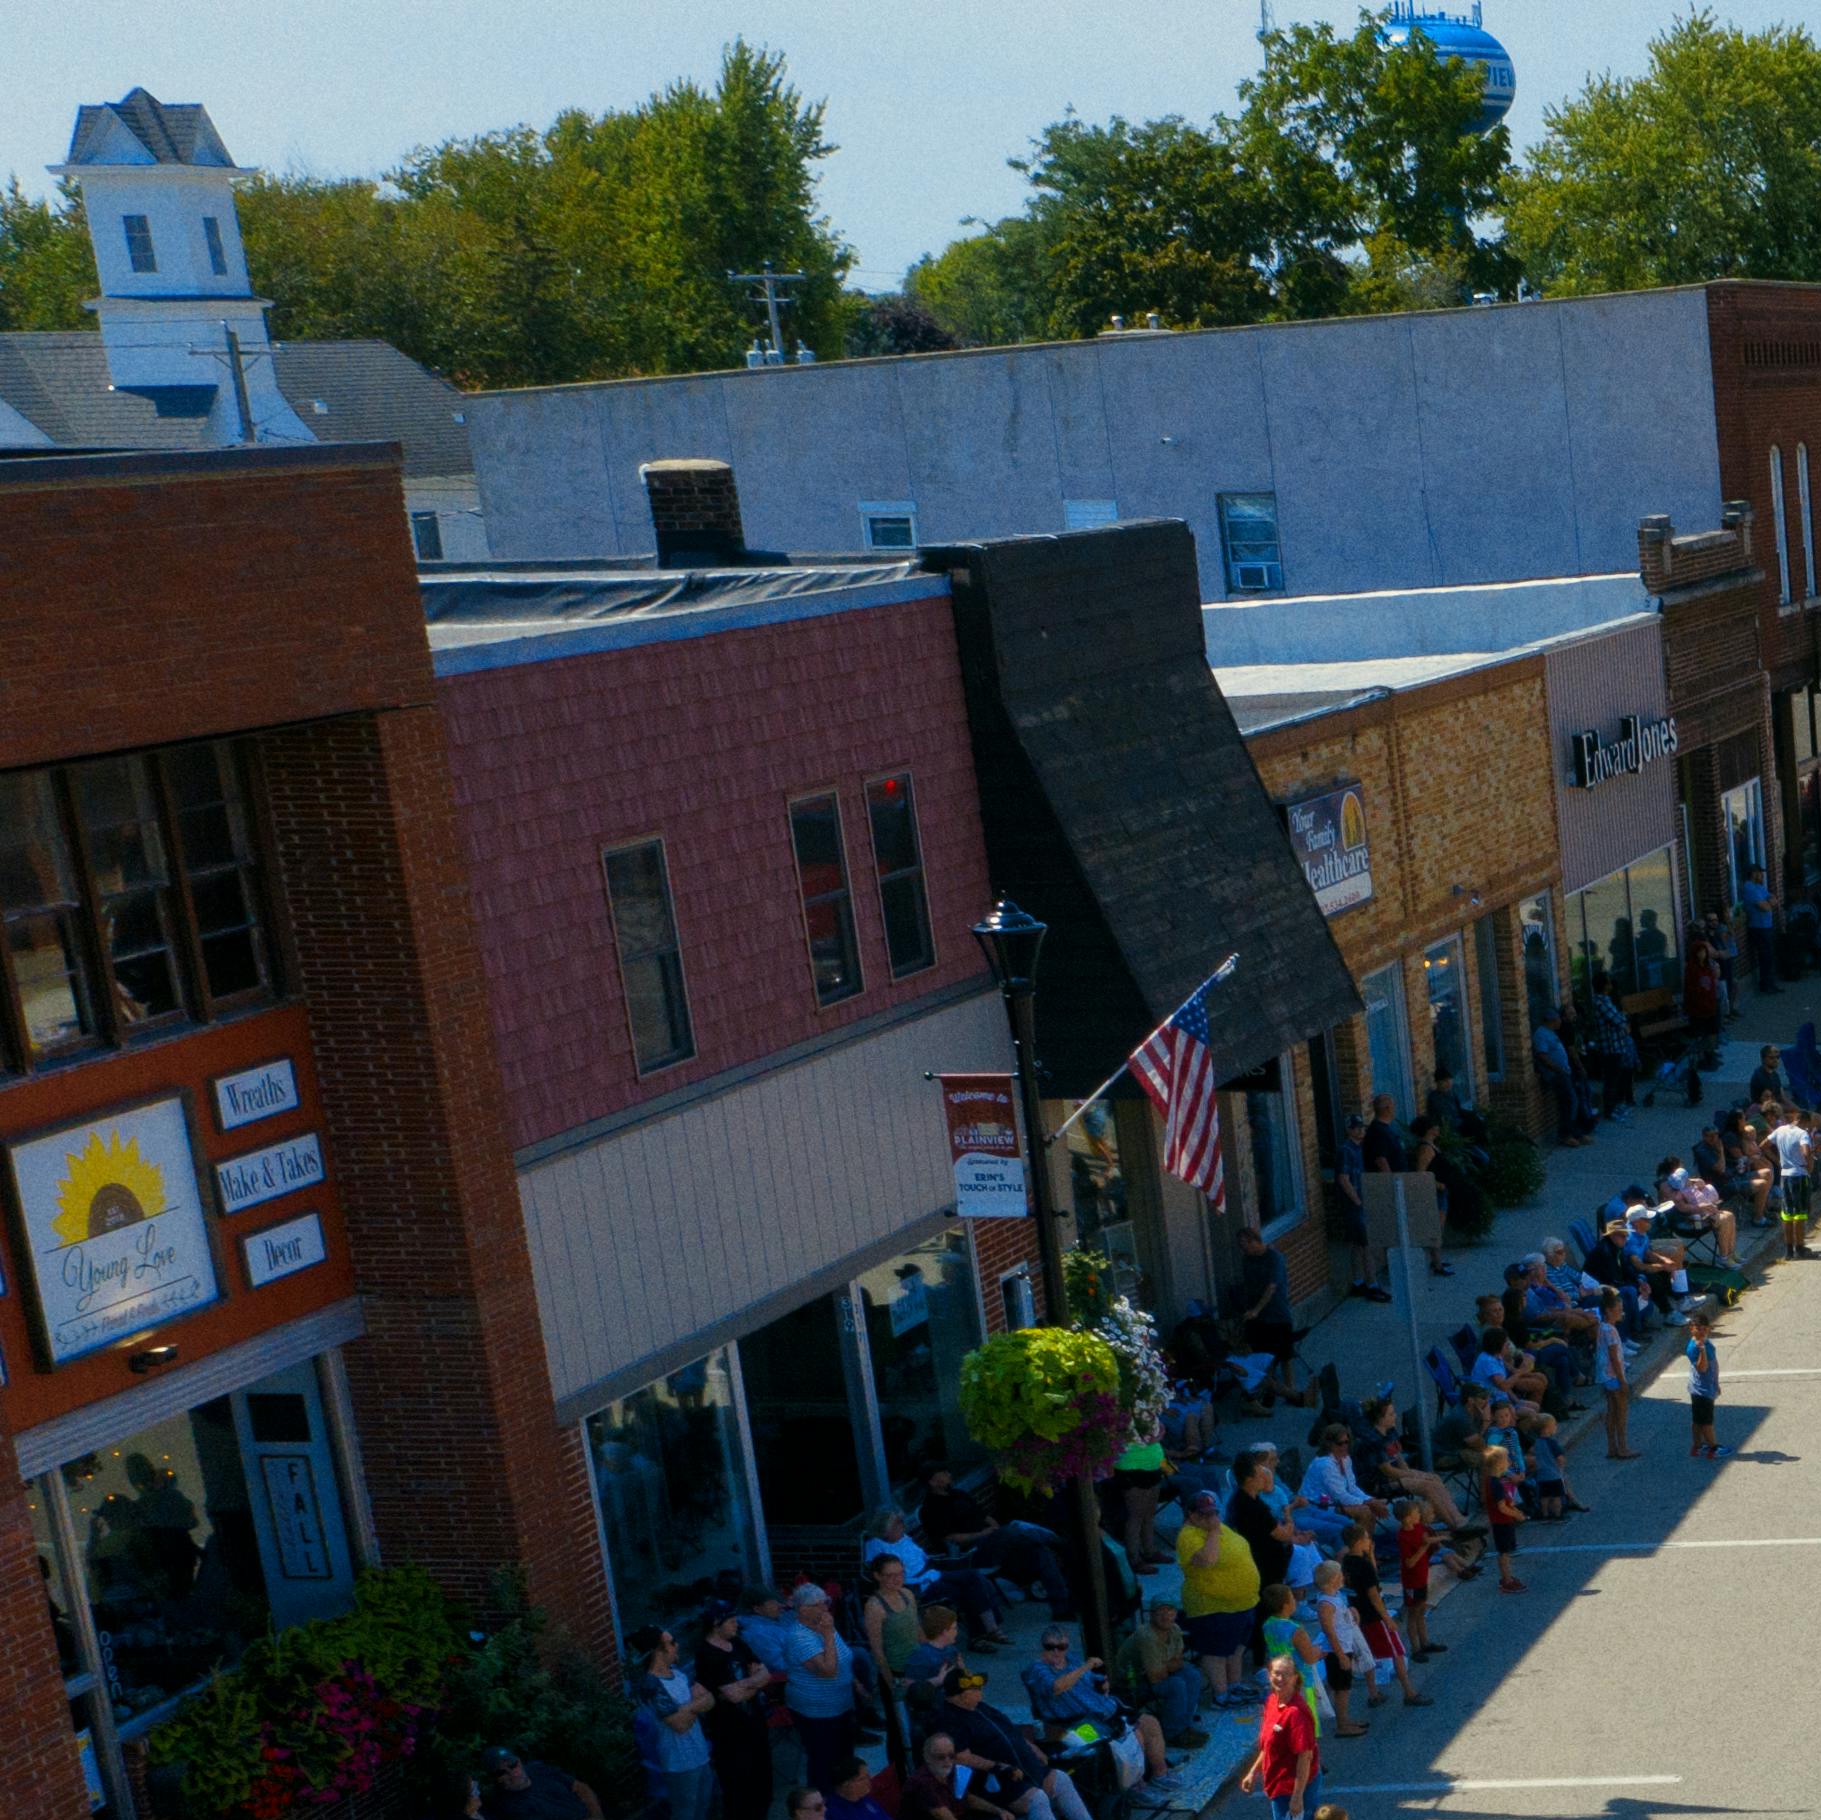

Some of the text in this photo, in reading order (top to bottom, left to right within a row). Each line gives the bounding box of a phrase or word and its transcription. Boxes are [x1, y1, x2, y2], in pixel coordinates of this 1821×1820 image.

[1582, 714, 1678, 788] Edward Jones
[226, 1073, 287, 1116] Wreaths
[954, 1134, 1015, 1146] PLAINVIEW
[220, 1146, 319, 1201] Make & Takes
[959, 1184, 987, 1192] TOUCH
[998, 1184, 1023, 1192] STYLE
[975, 1173, 1005, 1182] ERIN'S
[61, 1223, 176, 1312] Young Love
[263, 1235, 303, 1271] Decor
[287, 1462, 318, 1573] FALL
